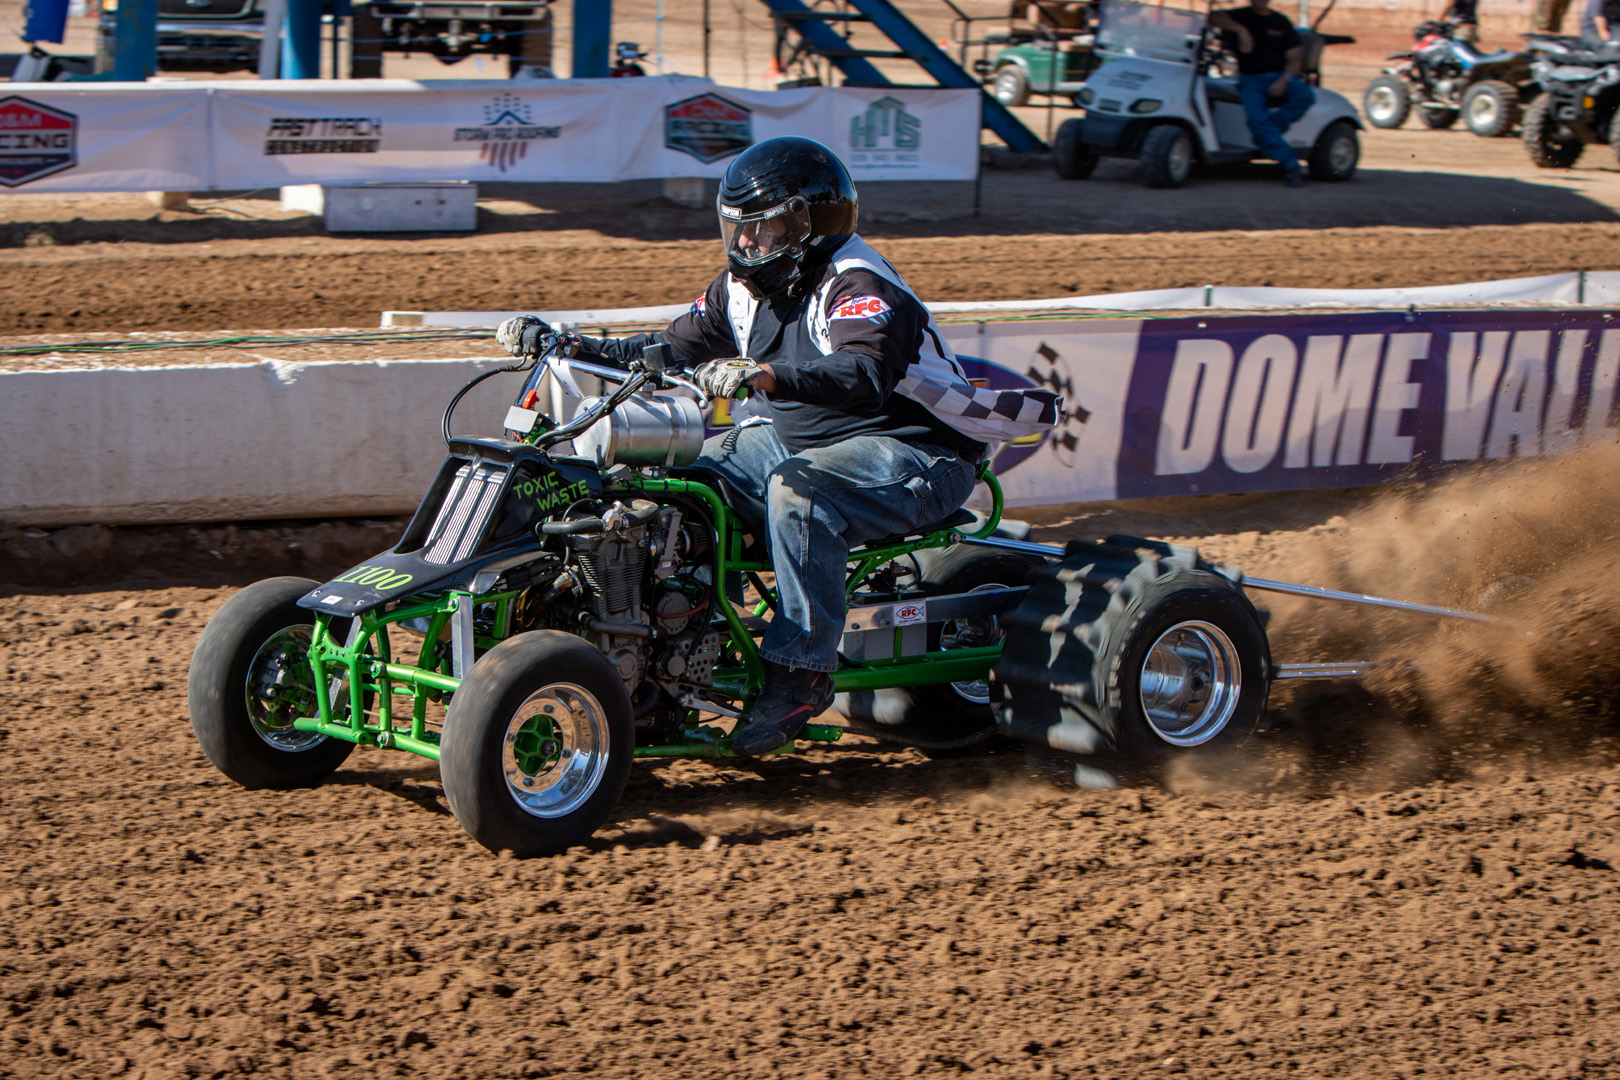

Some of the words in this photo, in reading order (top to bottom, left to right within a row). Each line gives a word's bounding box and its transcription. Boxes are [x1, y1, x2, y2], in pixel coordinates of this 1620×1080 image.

[840, 299, 881, 317] RFC
[1155, 333, 1431, 474] DOME
[513, 471, 559, 499] TOXIC
[537, 479, 591, 511] WASTE
[332, 564, 413, 590] 1100
[902, 609, 917, 618] RFC
